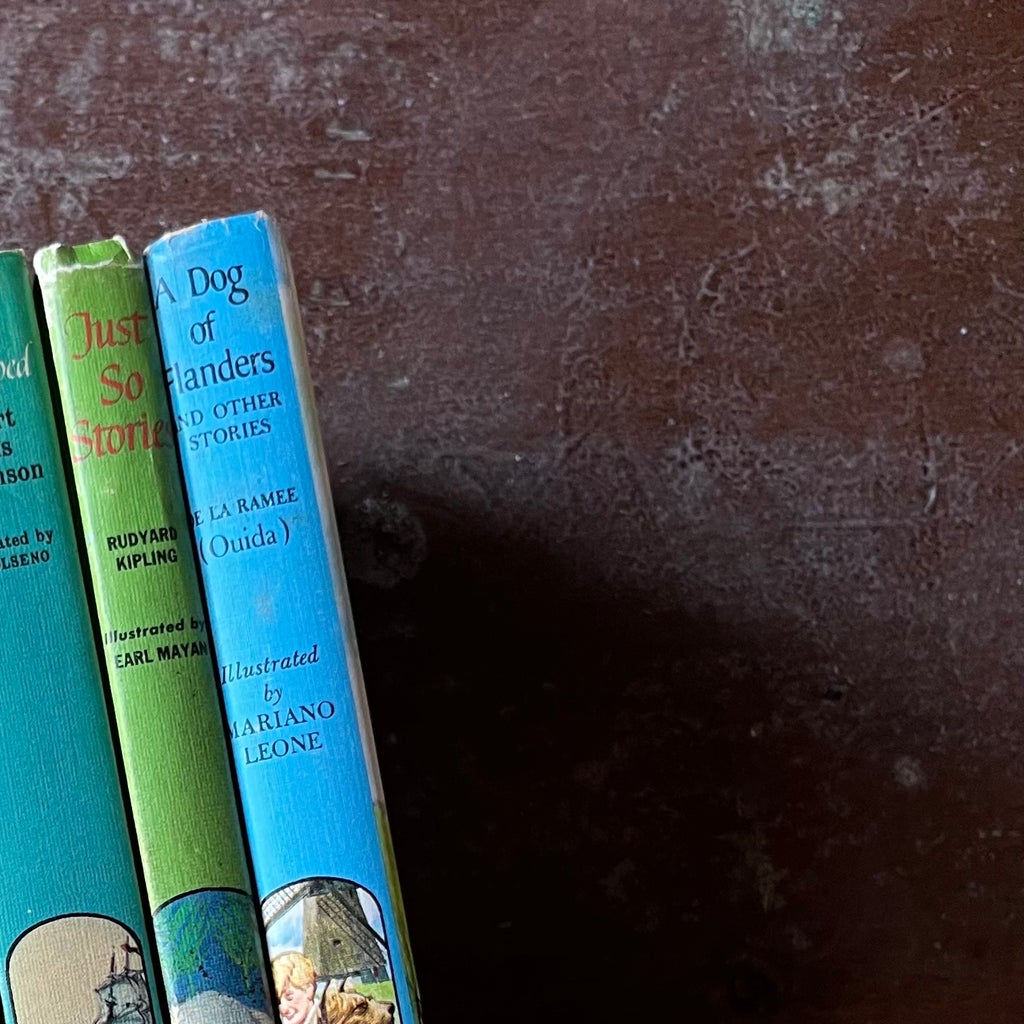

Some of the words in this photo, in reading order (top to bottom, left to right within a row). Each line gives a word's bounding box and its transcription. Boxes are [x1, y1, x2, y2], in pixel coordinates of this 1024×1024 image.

[155, 277, 176, 310] A
[187, 264, 249, 305] Dog
[64, 311, 147, 360] Just
[190, 310, 216, 345] of
[100, 364, 144, 406] So
[176, 409, 204, 433] ND
[213, 391, 282, 419] OTHER
[72, 412, 173, 463] Storie
[189, 418, 271, 451] STORIES
[191, 510, 204, 526] E
[209, 504, 231, 520] LA
[237, 487, 298, 514] RAMEE
[36, 528, 54, 544] by
[107, 527, 178, 551] RUDYARD
[199, 517, 290, 565] (Ouida)
[116, 549, 178, 571] KIPLING
[105, 618, 184, 645] Illustrated
[190, 616, 206, 632] by
[114, 651, 154, 669] EARL
[221, 644, 319, 686] Illustrated
[264, 683, 283, 706] by
[245, 732, 323, 765] LEONE
